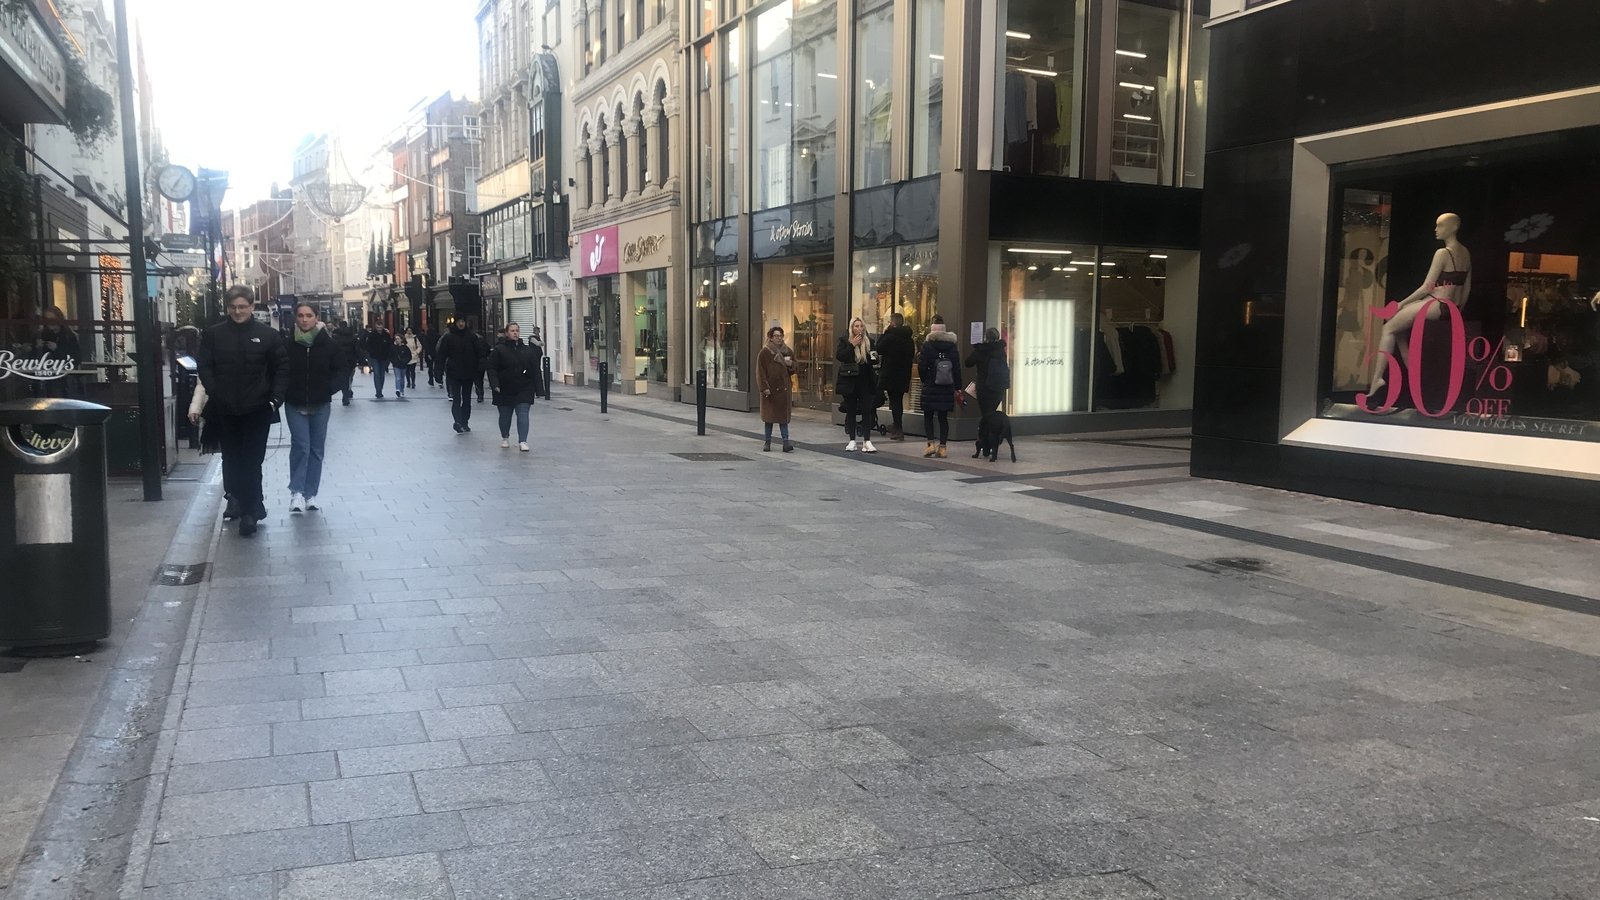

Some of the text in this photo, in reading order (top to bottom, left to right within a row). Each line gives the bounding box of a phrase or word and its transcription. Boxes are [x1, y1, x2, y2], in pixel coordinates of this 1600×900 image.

[770, 220, 814, 242] & other Stories
[589, 233, 605, 273] eir
[0, 350, 75, 376] Bewley's
[1355, 297, 1513, 418] 50%
[1465, 397, 1512, 419] OFF
[1531, 421, 1586, 435] SECRET
